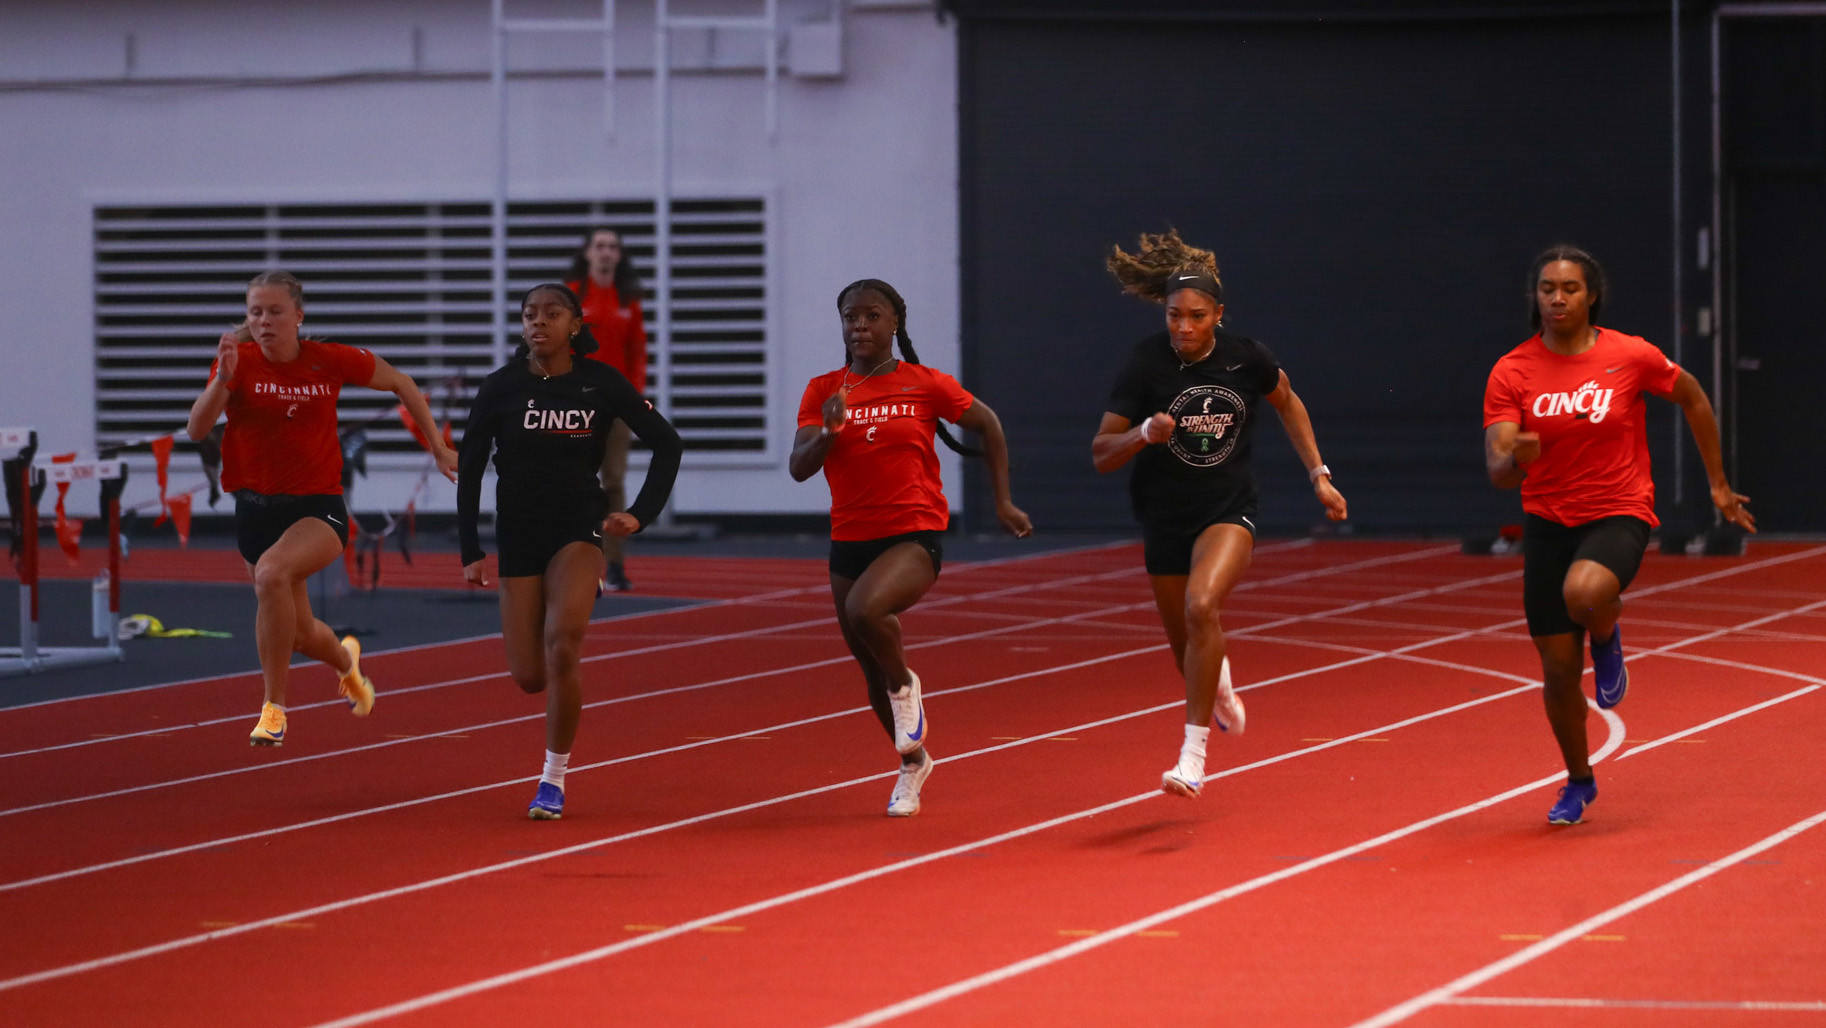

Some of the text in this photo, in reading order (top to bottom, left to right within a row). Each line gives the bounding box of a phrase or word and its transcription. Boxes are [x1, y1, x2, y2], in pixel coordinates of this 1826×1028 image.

[255, 382, 331, 396] CINCINNATI
[1214, 389, 1243, 412] AWARENESS
[1533, 381, 1614, 423] CINCY
[523, 410, 595, 429] CINCY
[846, 404, 916, 419] NCINNATI
[1180, 413, 1234, 427] STRENGTH
